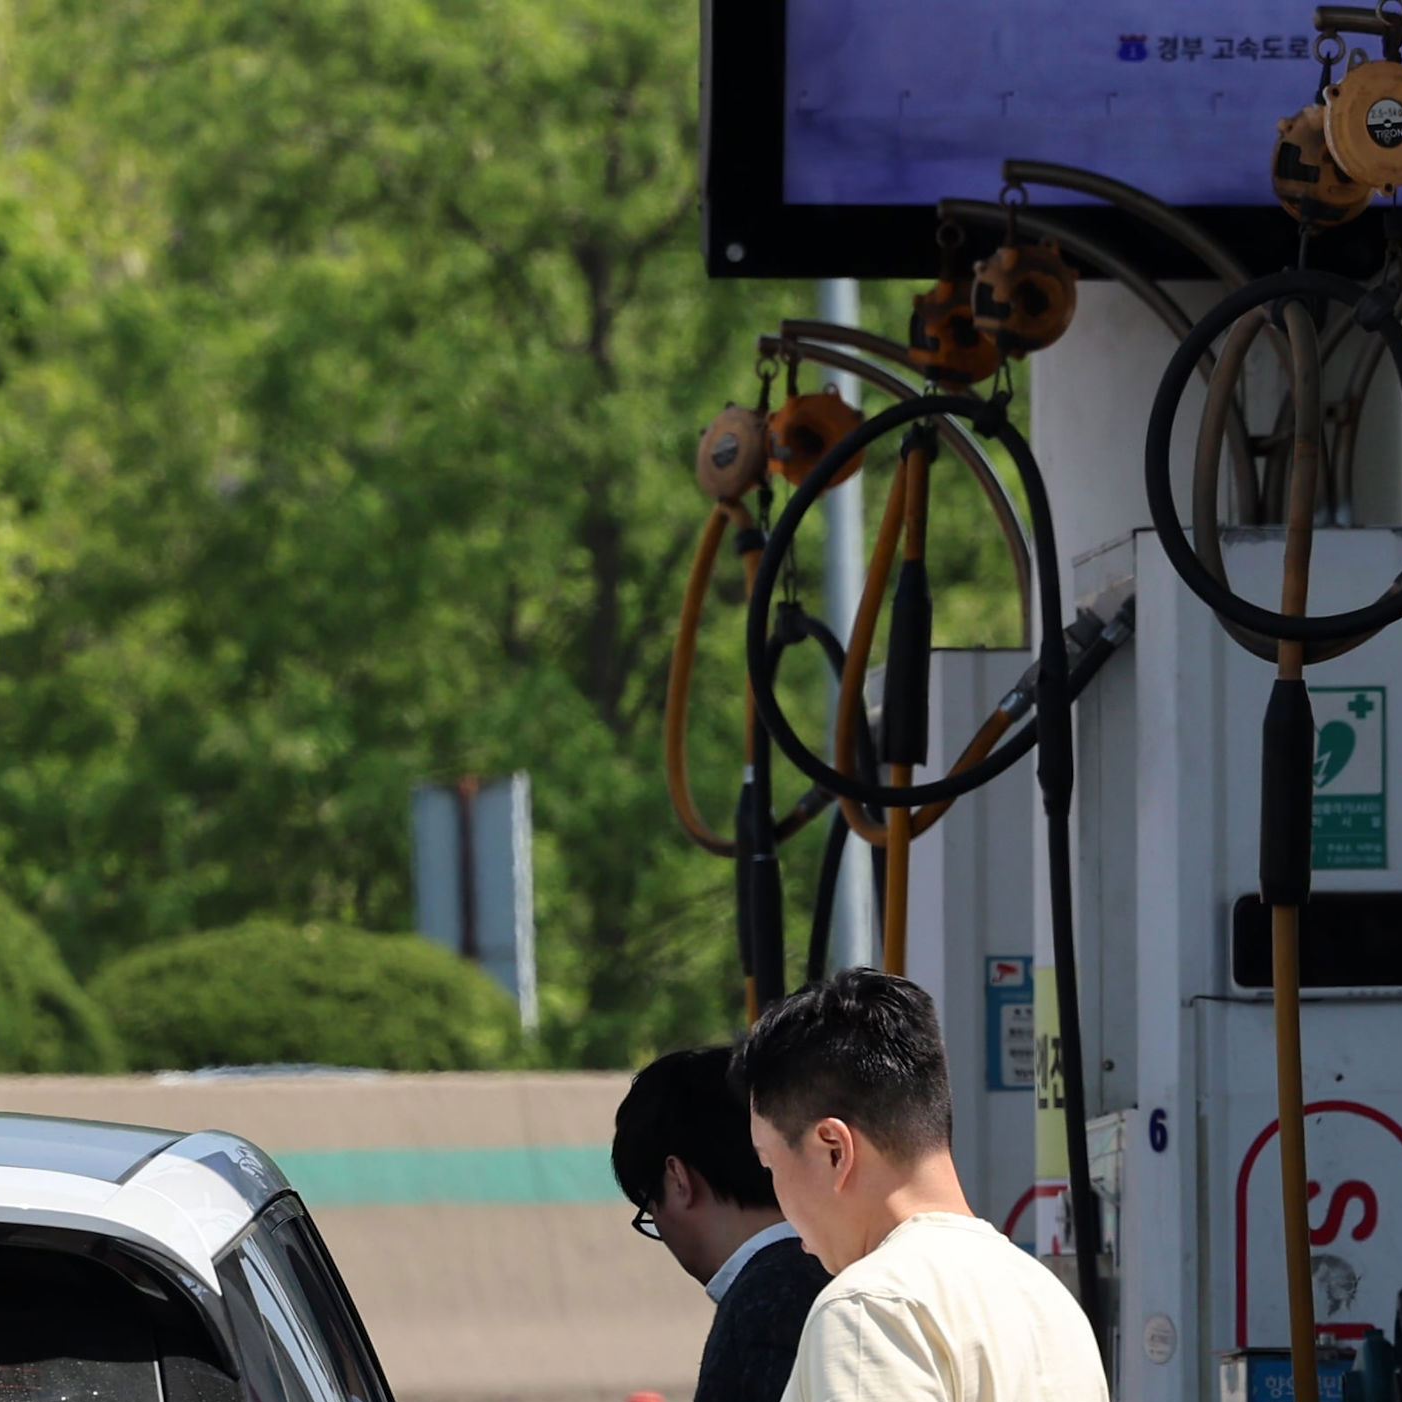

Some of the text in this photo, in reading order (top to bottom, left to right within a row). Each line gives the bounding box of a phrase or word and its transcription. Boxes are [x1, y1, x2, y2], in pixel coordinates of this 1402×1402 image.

[1159, 37, 1203, 62] 경부
[1211, 36, 1311, 62] 고속도로
[1150, 1108, 1168, 1153] 6
